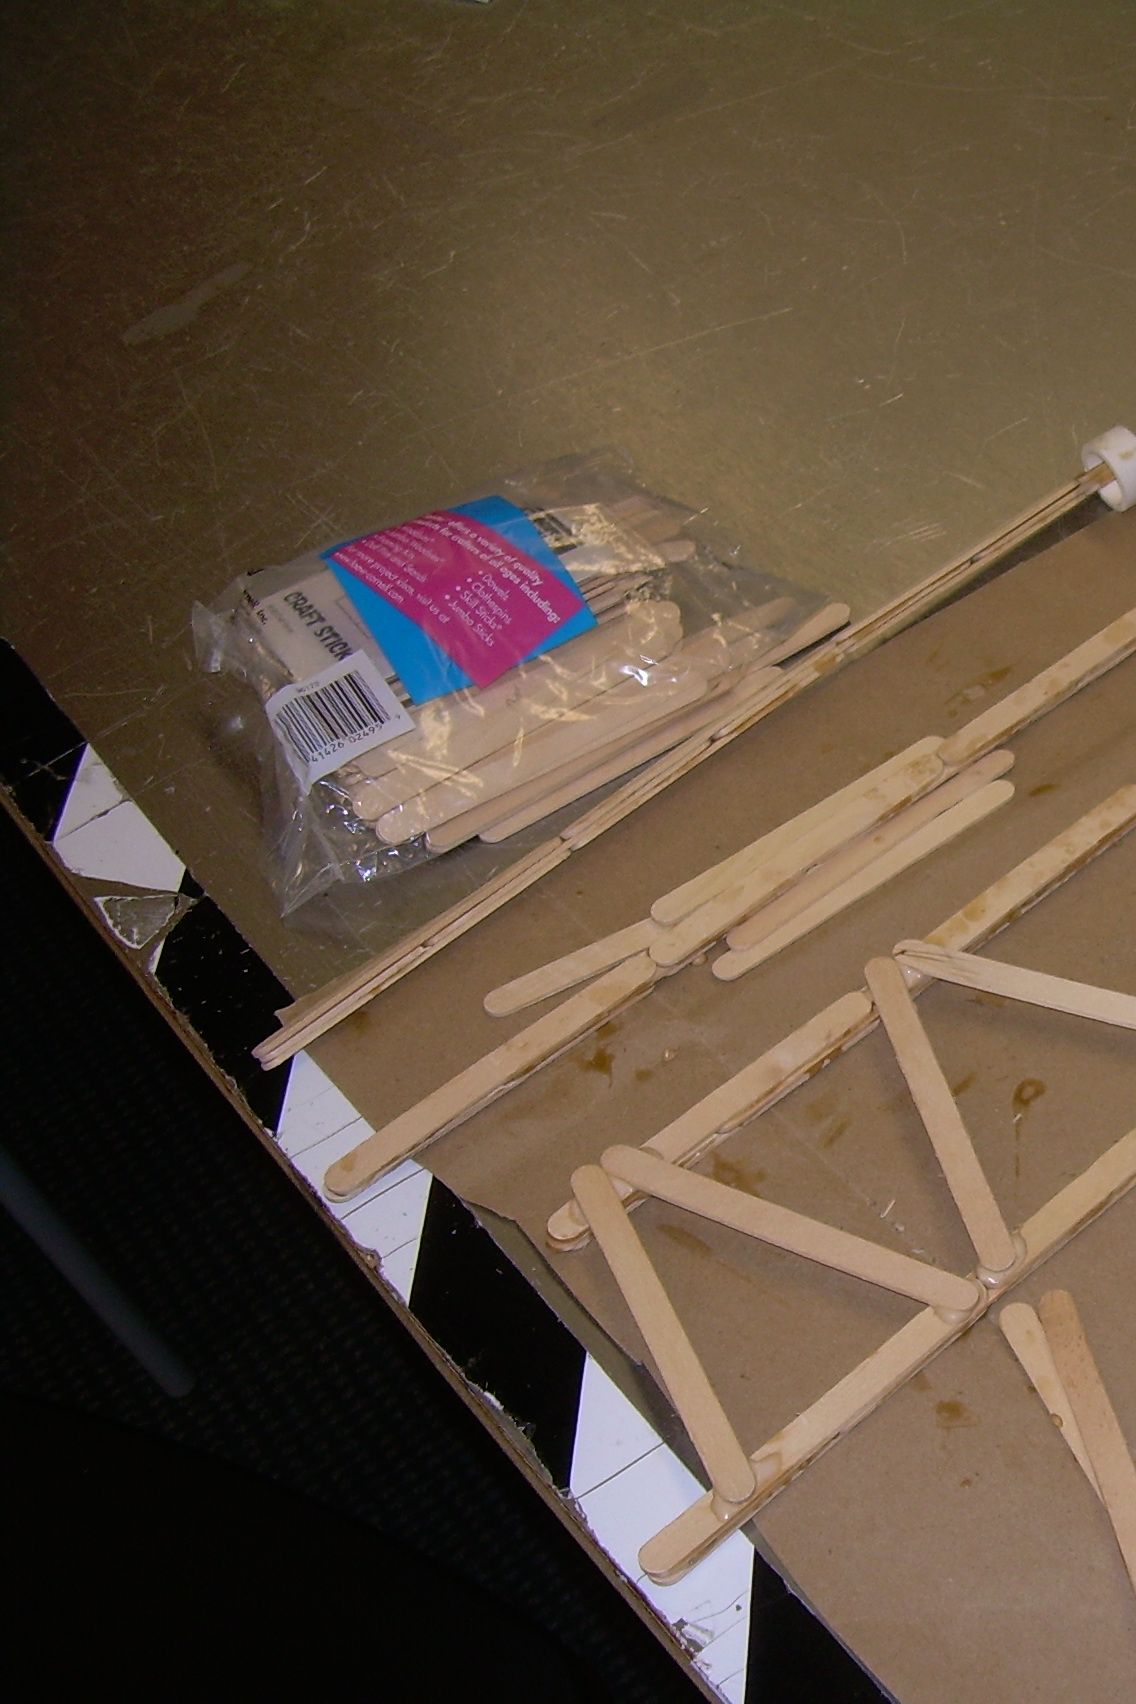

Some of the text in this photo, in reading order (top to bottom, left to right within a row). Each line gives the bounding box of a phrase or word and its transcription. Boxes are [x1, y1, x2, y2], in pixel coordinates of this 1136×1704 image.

[513, 560, 543, 586] quality
[283, 591, 327, 626] CRAFT
[472, 583, 512, 624] Clothespins
[500, 566, 522, 585] ages
[519, 580, 561, 624] including:
